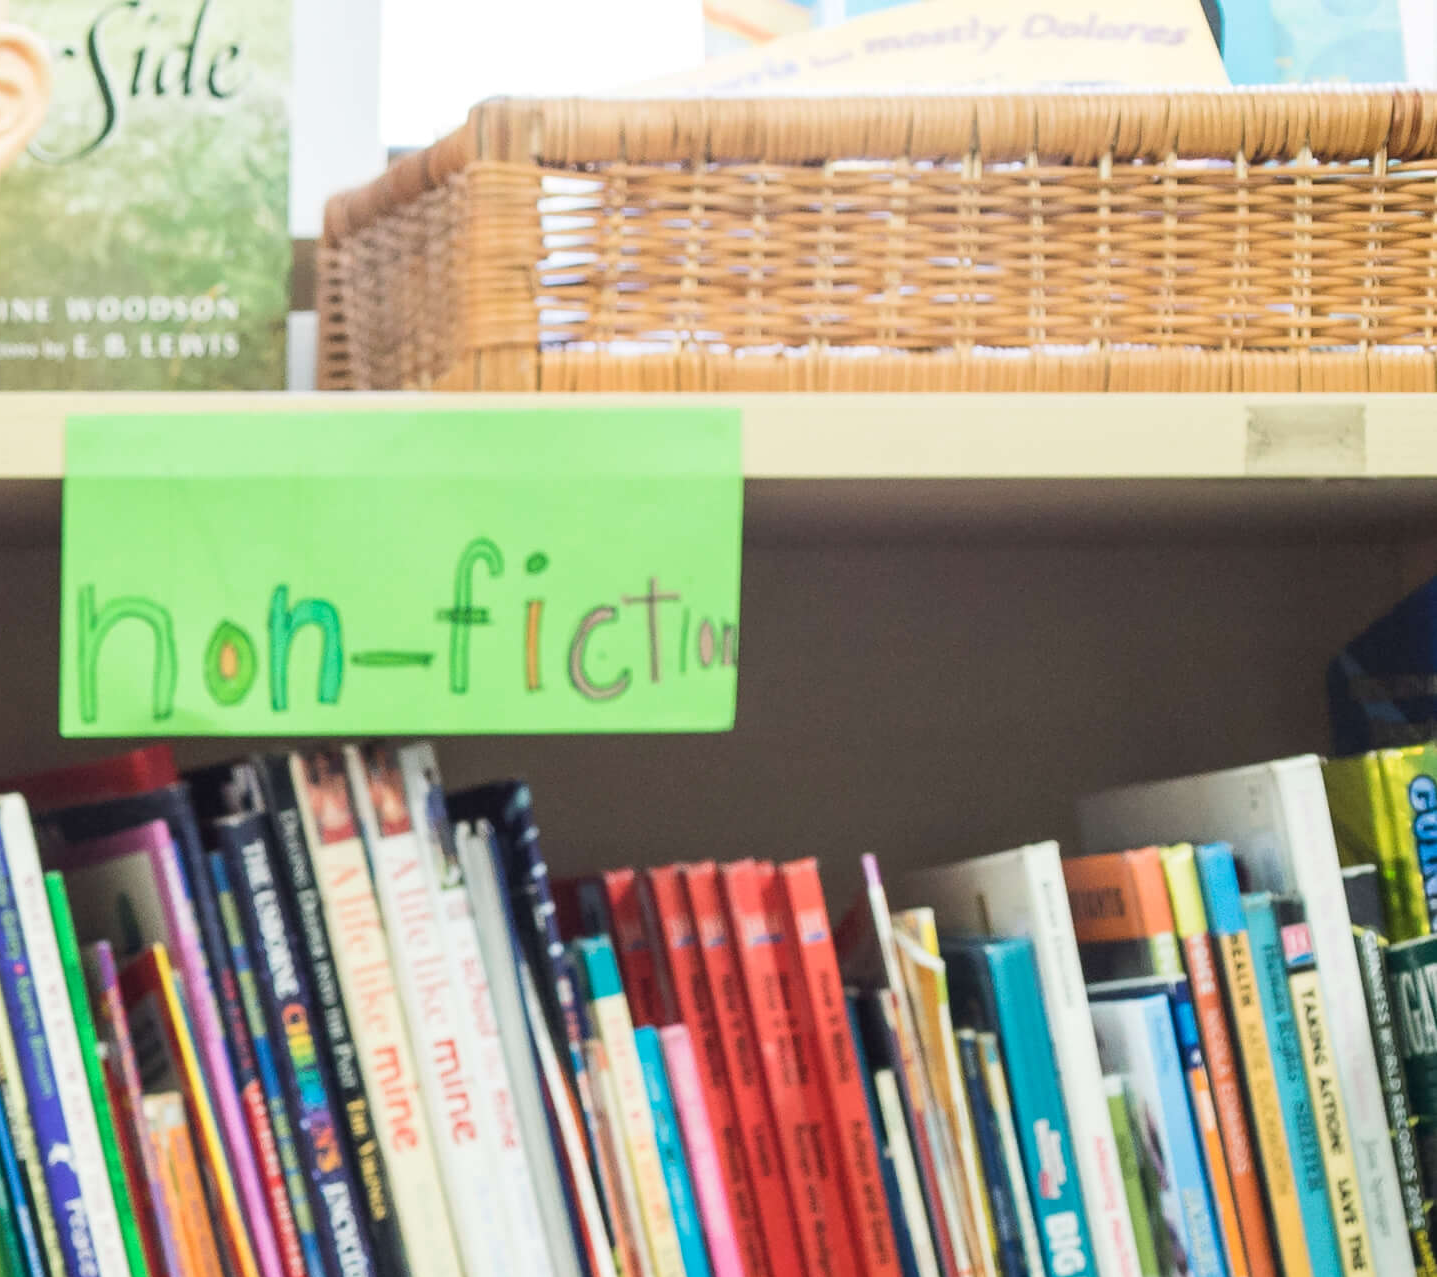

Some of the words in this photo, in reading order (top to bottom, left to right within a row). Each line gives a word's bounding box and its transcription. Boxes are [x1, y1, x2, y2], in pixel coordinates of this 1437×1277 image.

[1020, 12, 1191, 48] Dolores
[27, 0, 245, 163] Side
[65, 295, 239, 323] WOODSON
[140, 331, 239, 361] LEWIS
[78, 536, 739, 724] non-fiction
[333, 889, 386, 958] life
[347, 957, 405, 1038] like
[409, 951, 460, 1030] like
[1225, 932, 1256, 1008] HEALTH
[1355, 929, 1397, 1026] GUINNESS
[1297, 988, 1331, 1067] TAKING
[1374, 1023, 1409, 1093] WORLD
[369, 1039, 432, 1154] mine
[429, 1034, 485, 1147] mine
[1381, 1090, 1426, 1183] RECORDS
[1334, 1176, 1361, 1226] SAVE
[1043, 1209, 1088, 1277] BIG
[1346, 1234, 1370, 1271] THE
